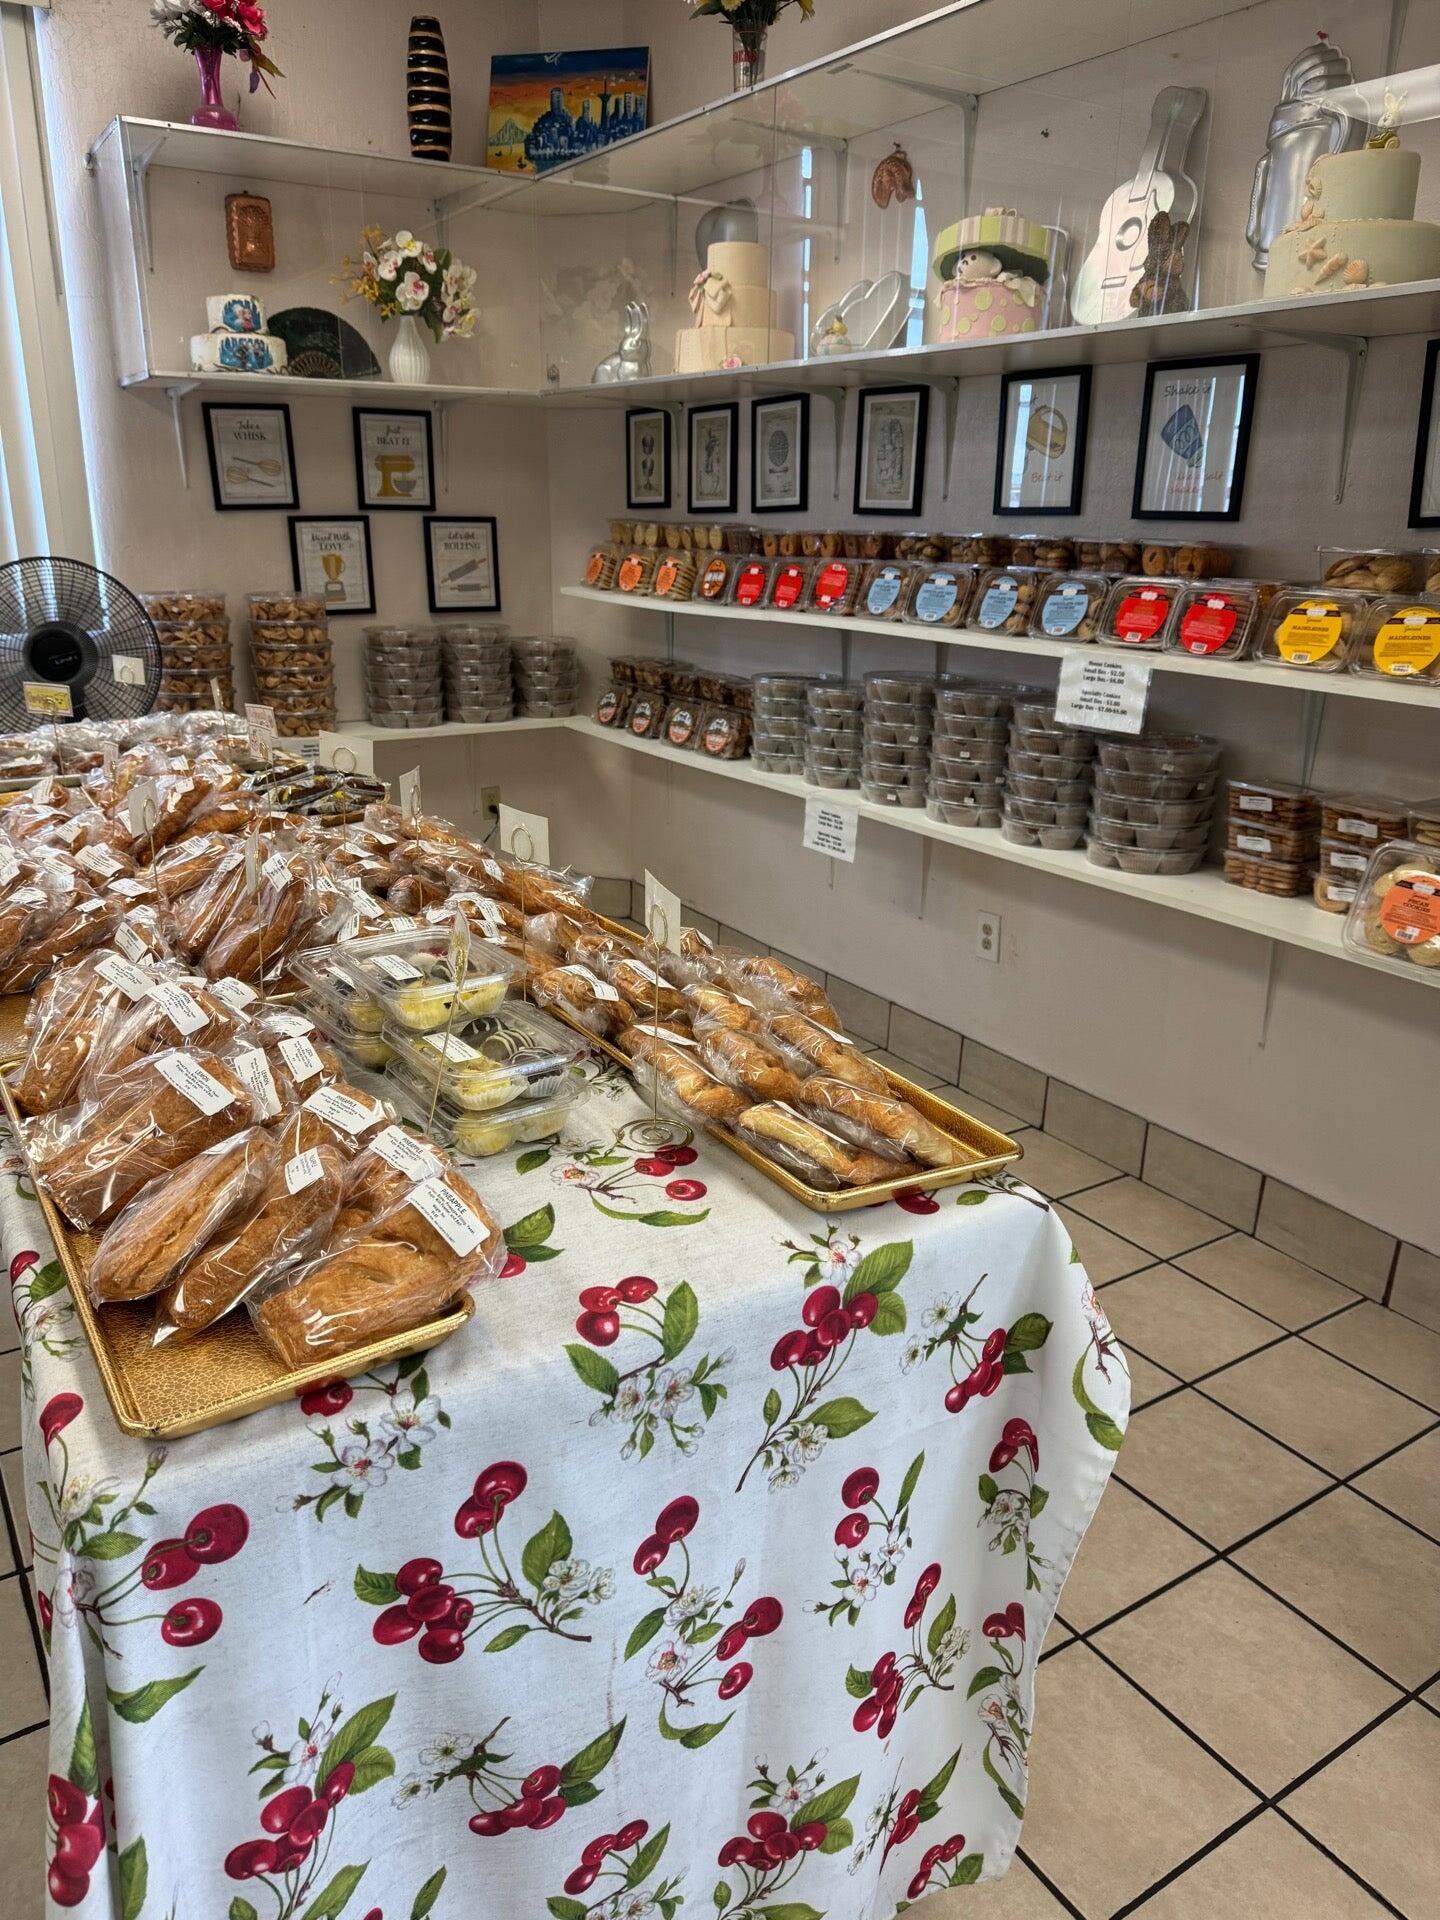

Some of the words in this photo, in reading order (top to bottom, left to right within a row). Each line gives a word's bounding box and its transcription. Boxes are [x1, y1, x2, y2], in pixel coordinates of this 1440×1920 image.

[1163, 385, 1199, 397] Shake
[232, 432, 267, 441] WHISK
[377, 436, 399, 445] BEAT
[319, 542, 344, 550] LOVE
[443, 542, 481, 551] ROLLING
[1082, 689, 1101, 697] Specialty
[1408, 898, 1430, 907] PECAN
[1403, 903, 1431, 913] COOKIES
[194, 1068, 211, 1083] LEMON
[259, 1069, 271, 1085] LEMON
[400, 1135, 424, 1155] PINEAPPLE
[439, 1187, 467, 1215] PINEAPPLE
